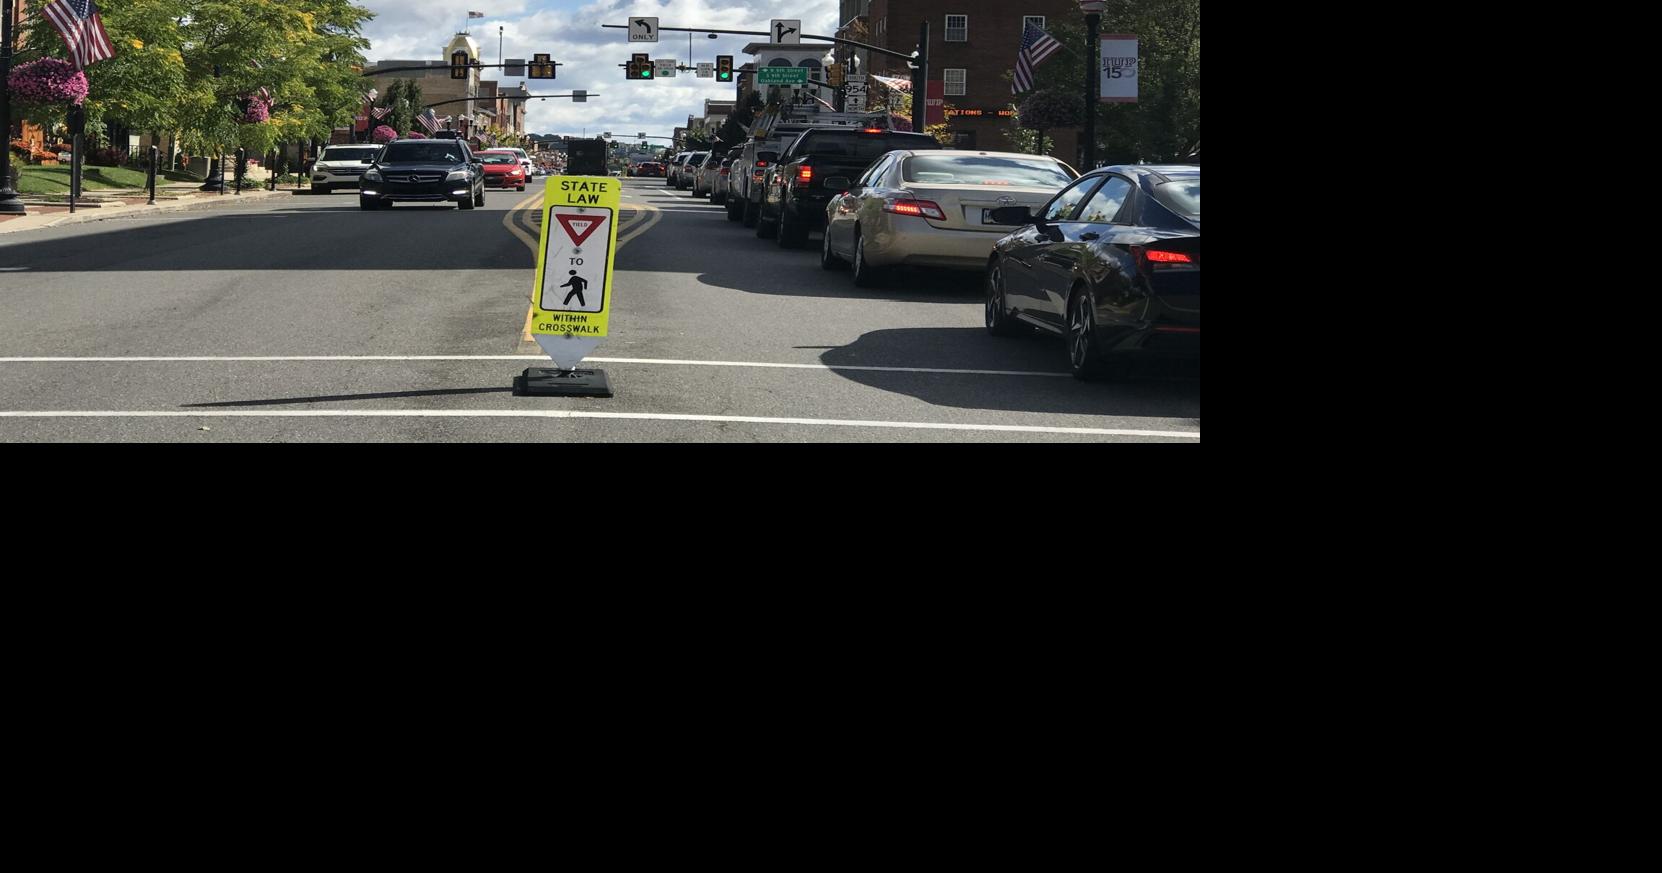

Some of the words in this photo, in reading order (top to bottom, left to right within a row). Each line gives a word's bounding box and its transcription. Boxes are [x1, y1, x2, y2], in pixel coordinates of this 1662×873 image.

[1102, 57, 1136, 68] IUP
[845, 85, 866, 93] 954
[562, 181, 608, 193] STATE
[568, 194, 600, 205] LAW
[569, 258, 584, 266] TO
[552, 313, 588, 323] WITHIN
[538, 322, 600, 334] CROSSWALK
